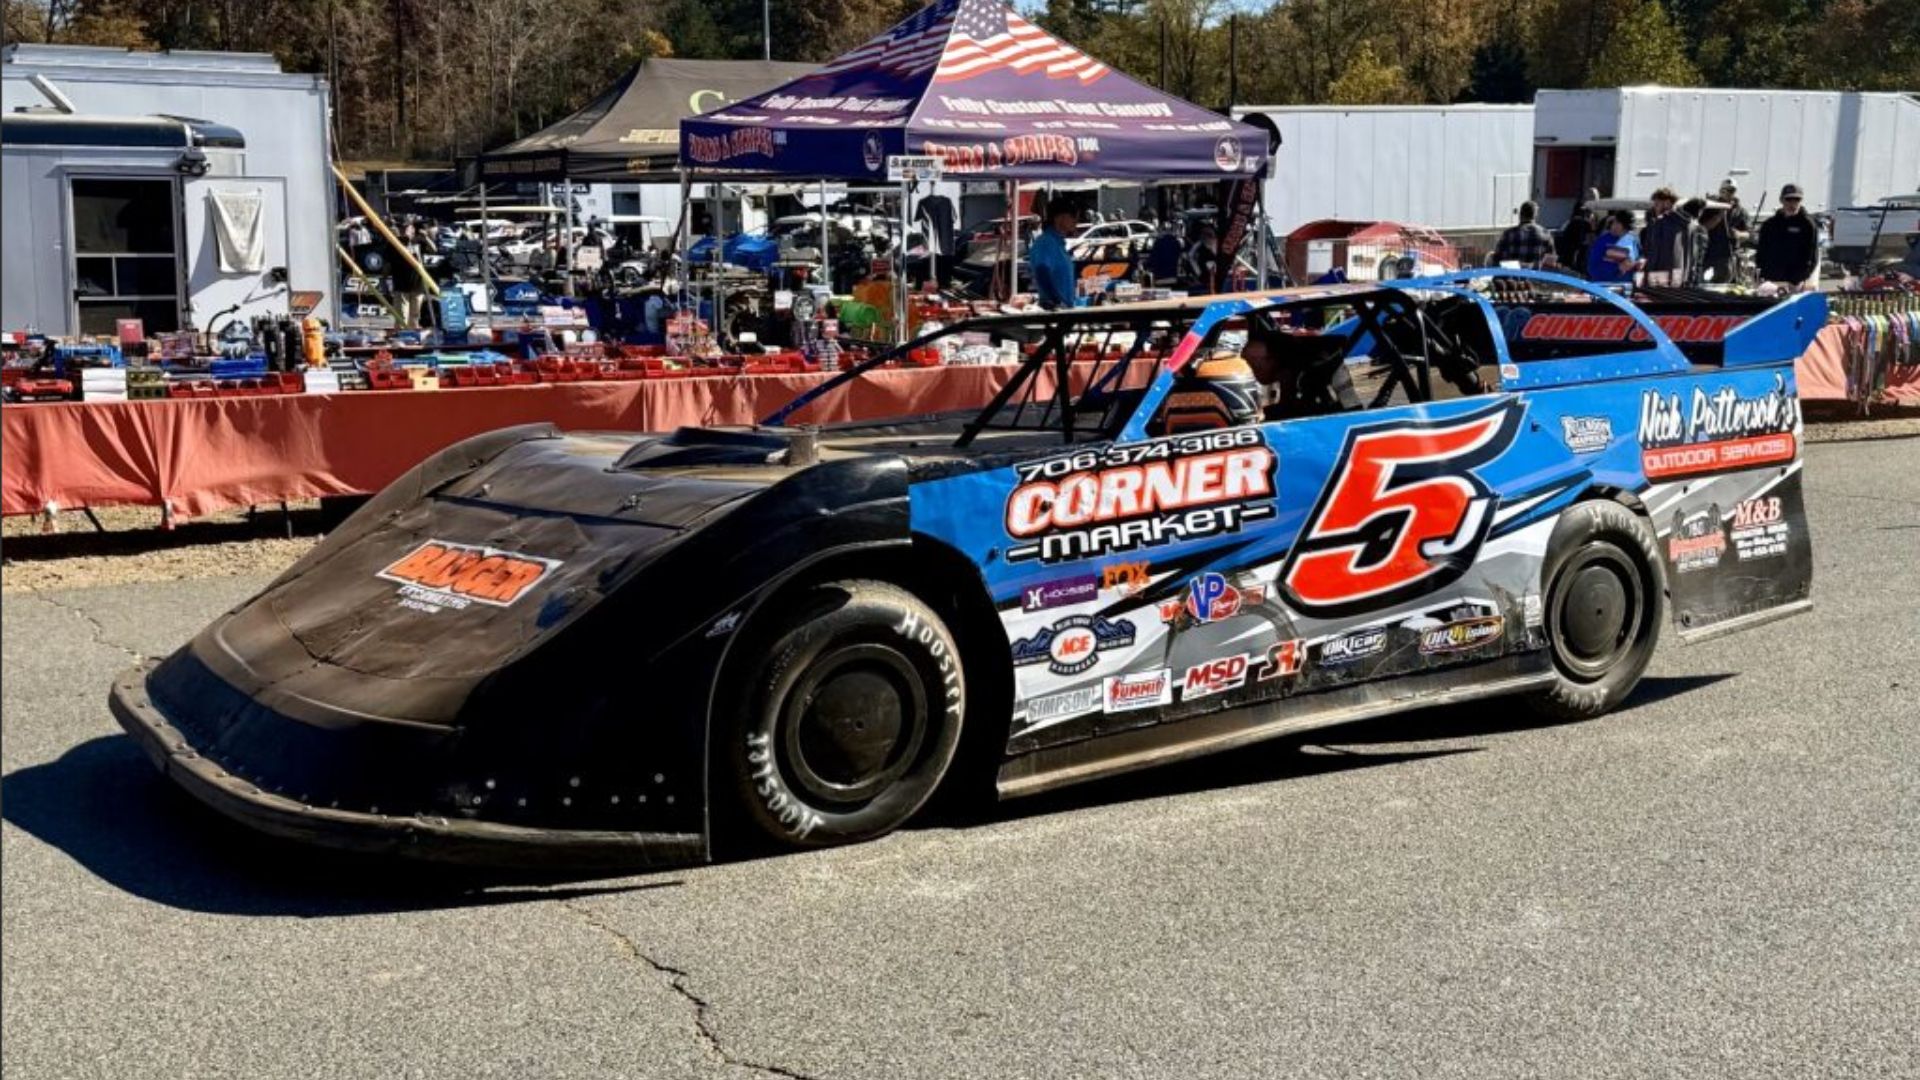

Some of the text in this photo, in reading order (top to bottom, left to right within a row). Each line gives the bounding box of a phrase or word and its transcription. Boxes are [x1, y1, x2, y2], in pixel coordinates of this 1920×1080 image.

[939, 95, 1173, 117] Fully Custom Tour Canopy
[1003, 133, 1078, 167] STRIPES
[1521, 314, 1631, 340] GUNNER
[1638, 390, 1684, 444] Nick
[1017, 428, 1259, 482] 706-374-3166
[1645, 439, 1787, 471] OUTDOOR SERVICES
[1007, 447, 1276, 536] CORNER
[1284, 408, 1510, 606] 5
[1733, 497, 1782, 529] M&B
[1189, 572, 1226, 621] VP
[1057, 634, 1092, 657] ACE
[1110, 675, 1166, 702] SUMMIT
[1186, 656, 1247, 690] MSD
[1028, 690, 1092, 718] SIMPSON
